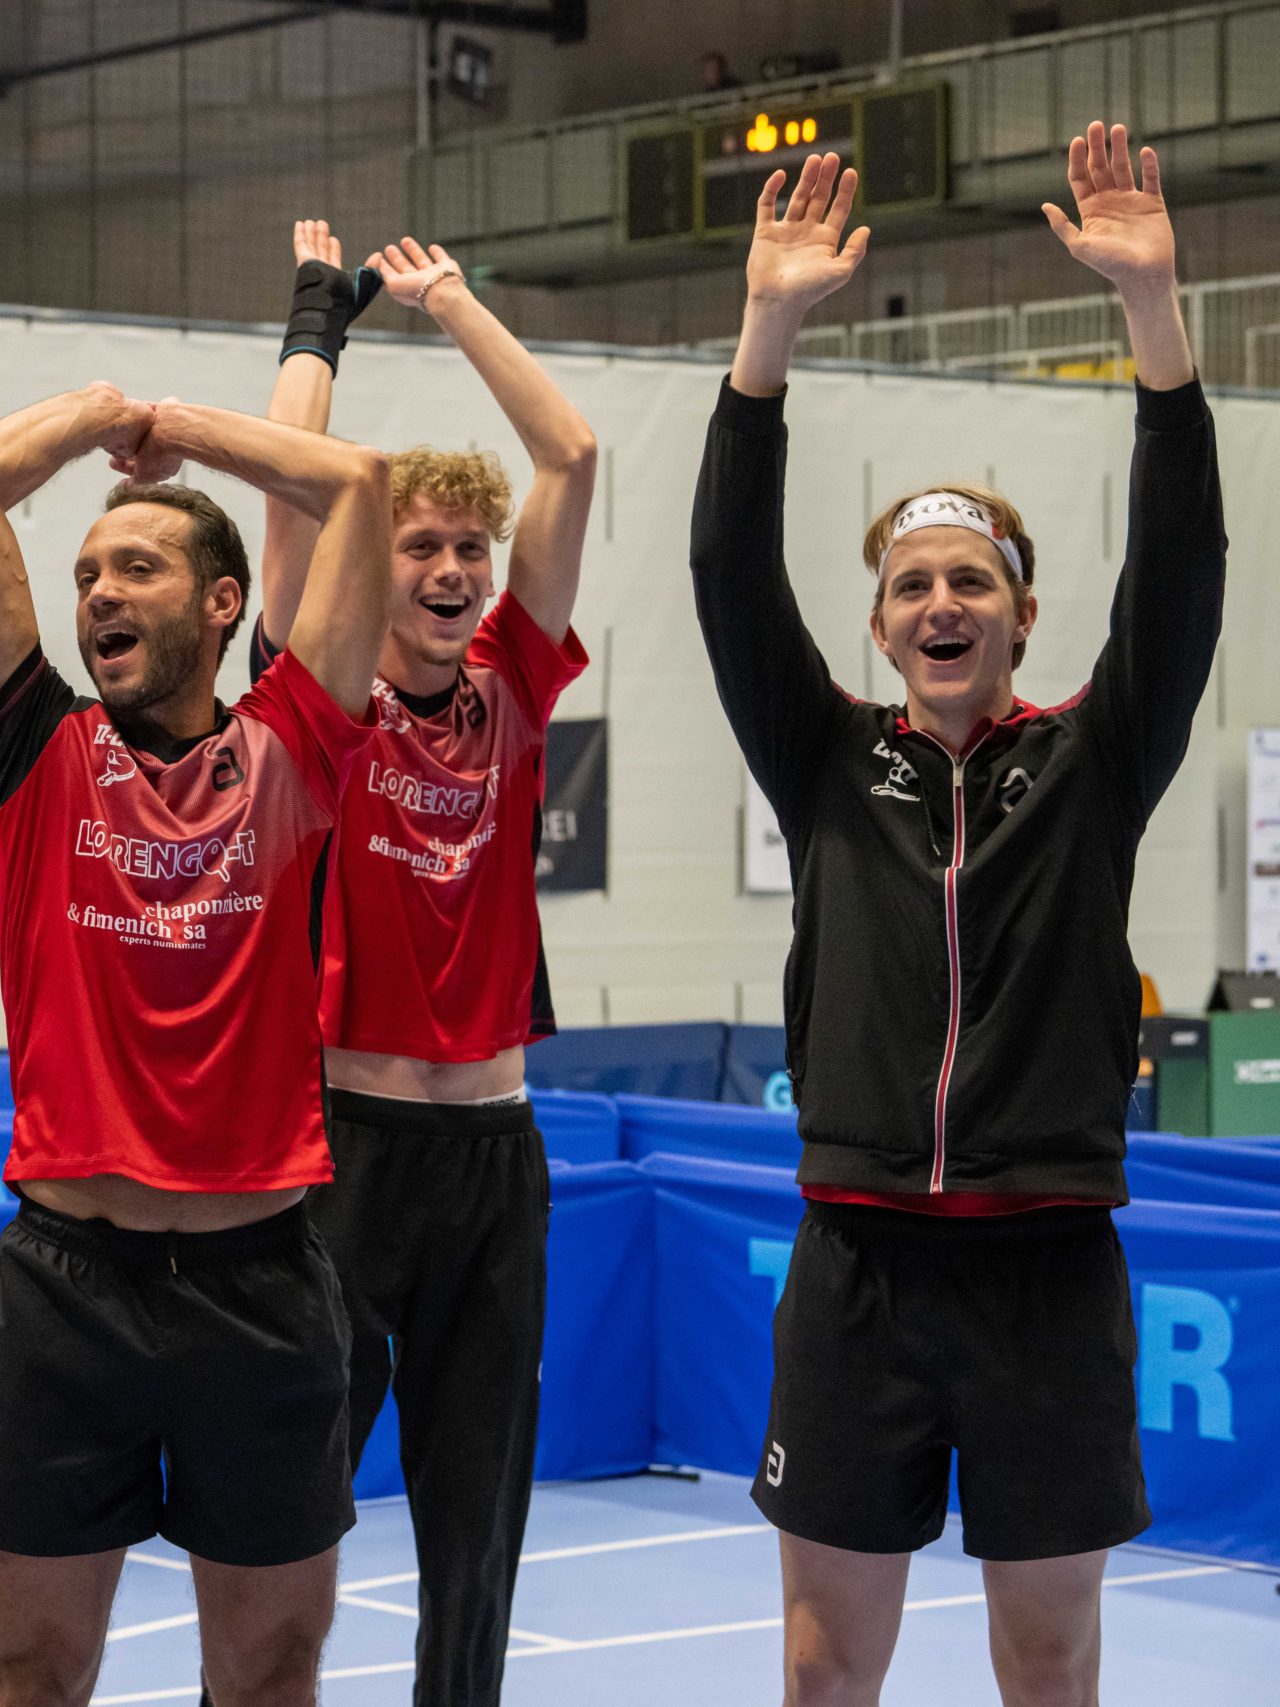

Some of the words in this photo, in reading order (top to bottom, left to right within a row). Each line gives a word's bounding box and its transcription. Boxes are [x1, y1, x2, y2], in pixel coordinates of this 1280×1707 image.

[66, 902, 80, 924] &
[183, 923, 207, 940] sa
[119, 934, 151, 947] experts
[153, 938, 207, 951] numismates
